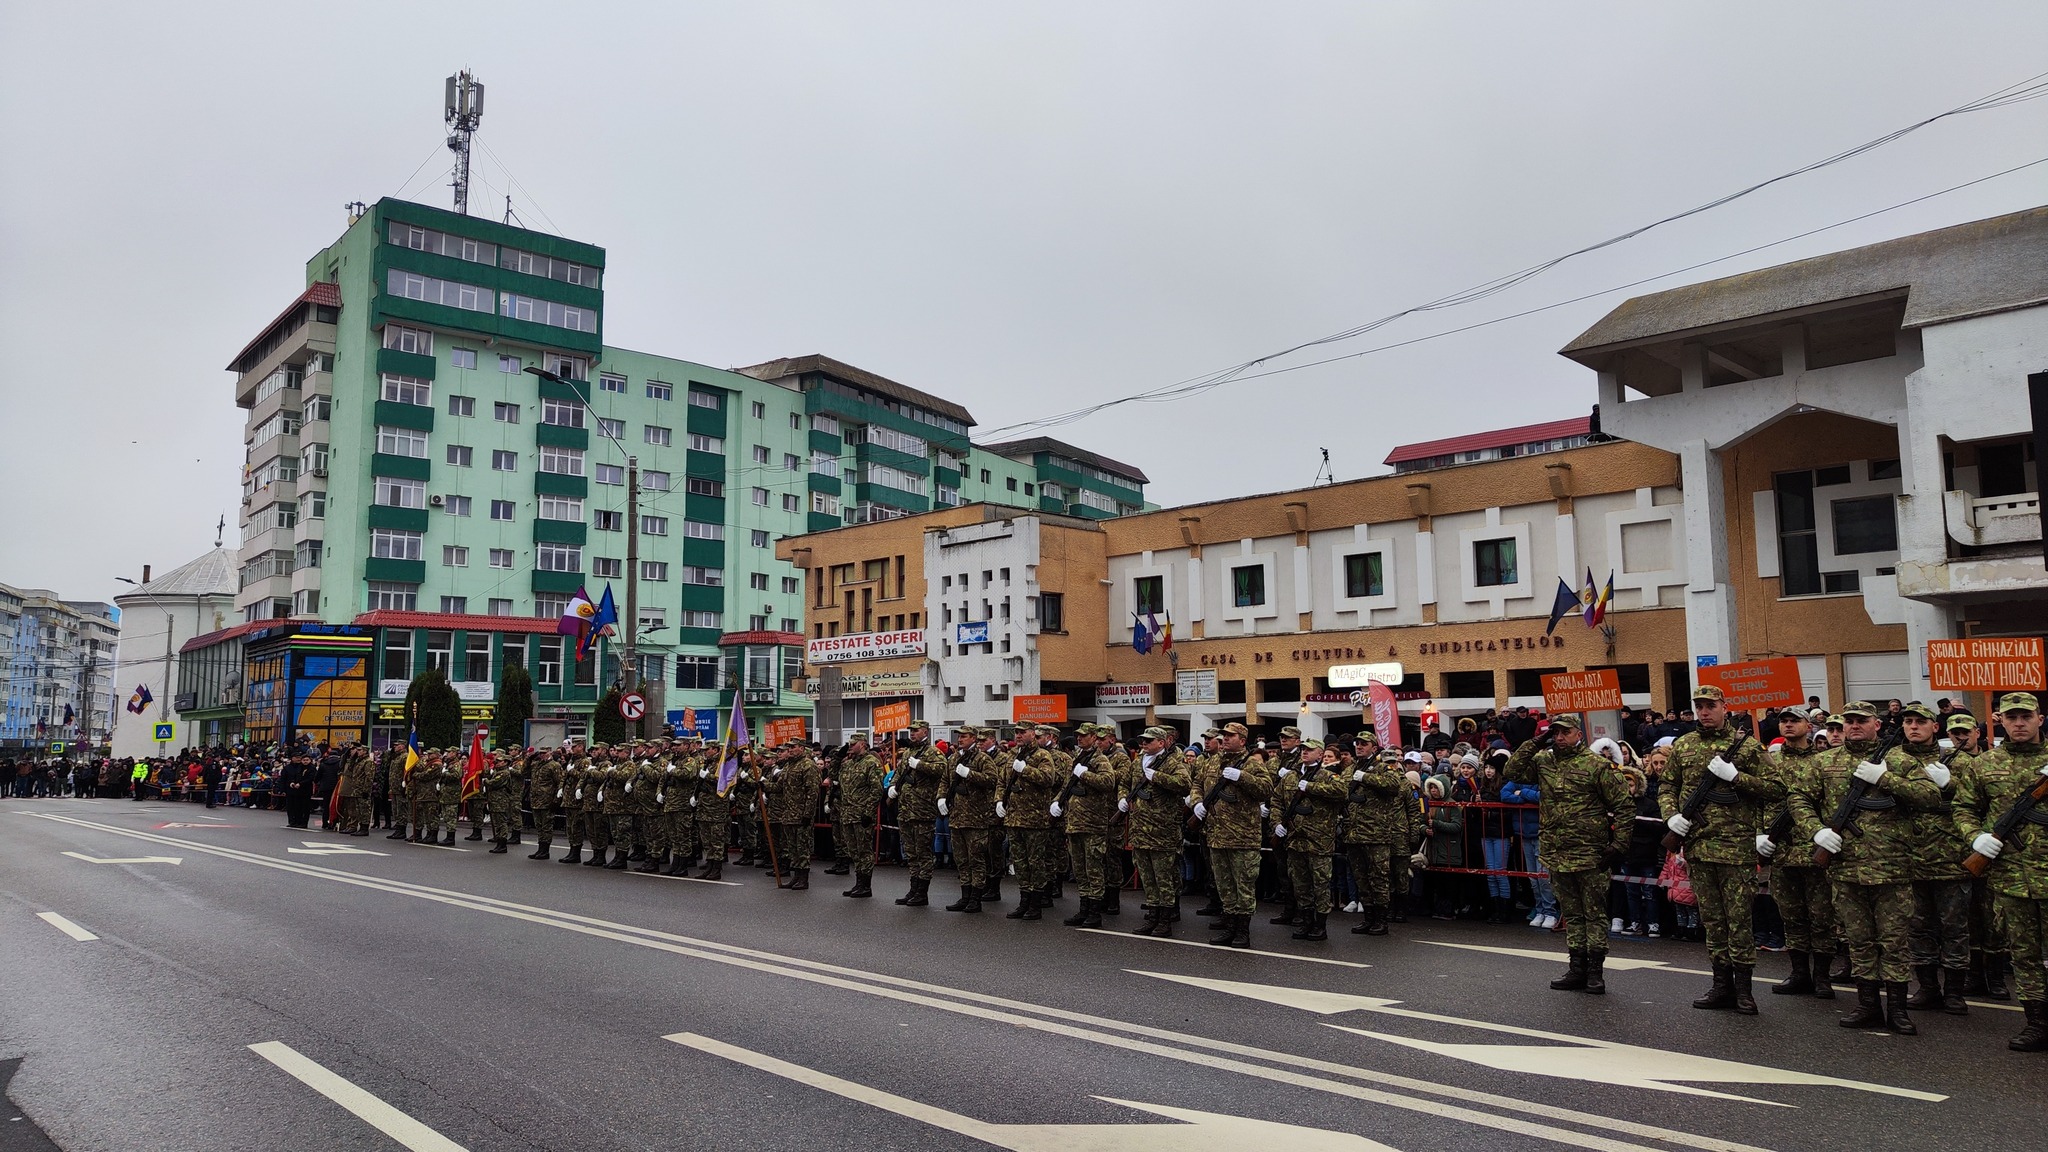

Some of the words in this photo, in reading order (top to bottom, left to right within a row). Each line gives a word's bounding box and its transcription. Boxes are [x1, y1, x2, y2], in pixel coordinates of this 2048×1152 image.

[300, 623, 335, 634] Blue
[337, 625, 363, 635] Air
[810, 636, 871, 652] ATESTATE
[875, 631, 923, 649] ȘOFERI
[827, 652, 852, 661] 0756
[856, 649, 875, 658] 108
[878, 648, 898, 656] 336
[1200, 653, 1237, 665] CASA
[1254, 651, 1274, 663] DE
[1292, 647, 1367, 661] CULTURA
[1388, 645, 1398, 657] A
[1419, 636, 1565, 655] SINDICATELOR
[1931, 642, 1967, 661] ȘCOALA
[872, 672, 910, 680] GOLD
[1368, 672, 1397, 682] Bistro
[1721, 666, 1774, 680] COLEGIUL
[1934, 660, 1996, 687] CALISTRAT
[2000, 661, 2042, 690] HOGAȘ
[1096, 687, 1120, 698] ȘCOALA
[1120, 686, 1128, 695] DE
[1129, 685, 1150, 698] ȘOFERI
[1729, 680, 1769, 692] TEHNIC
